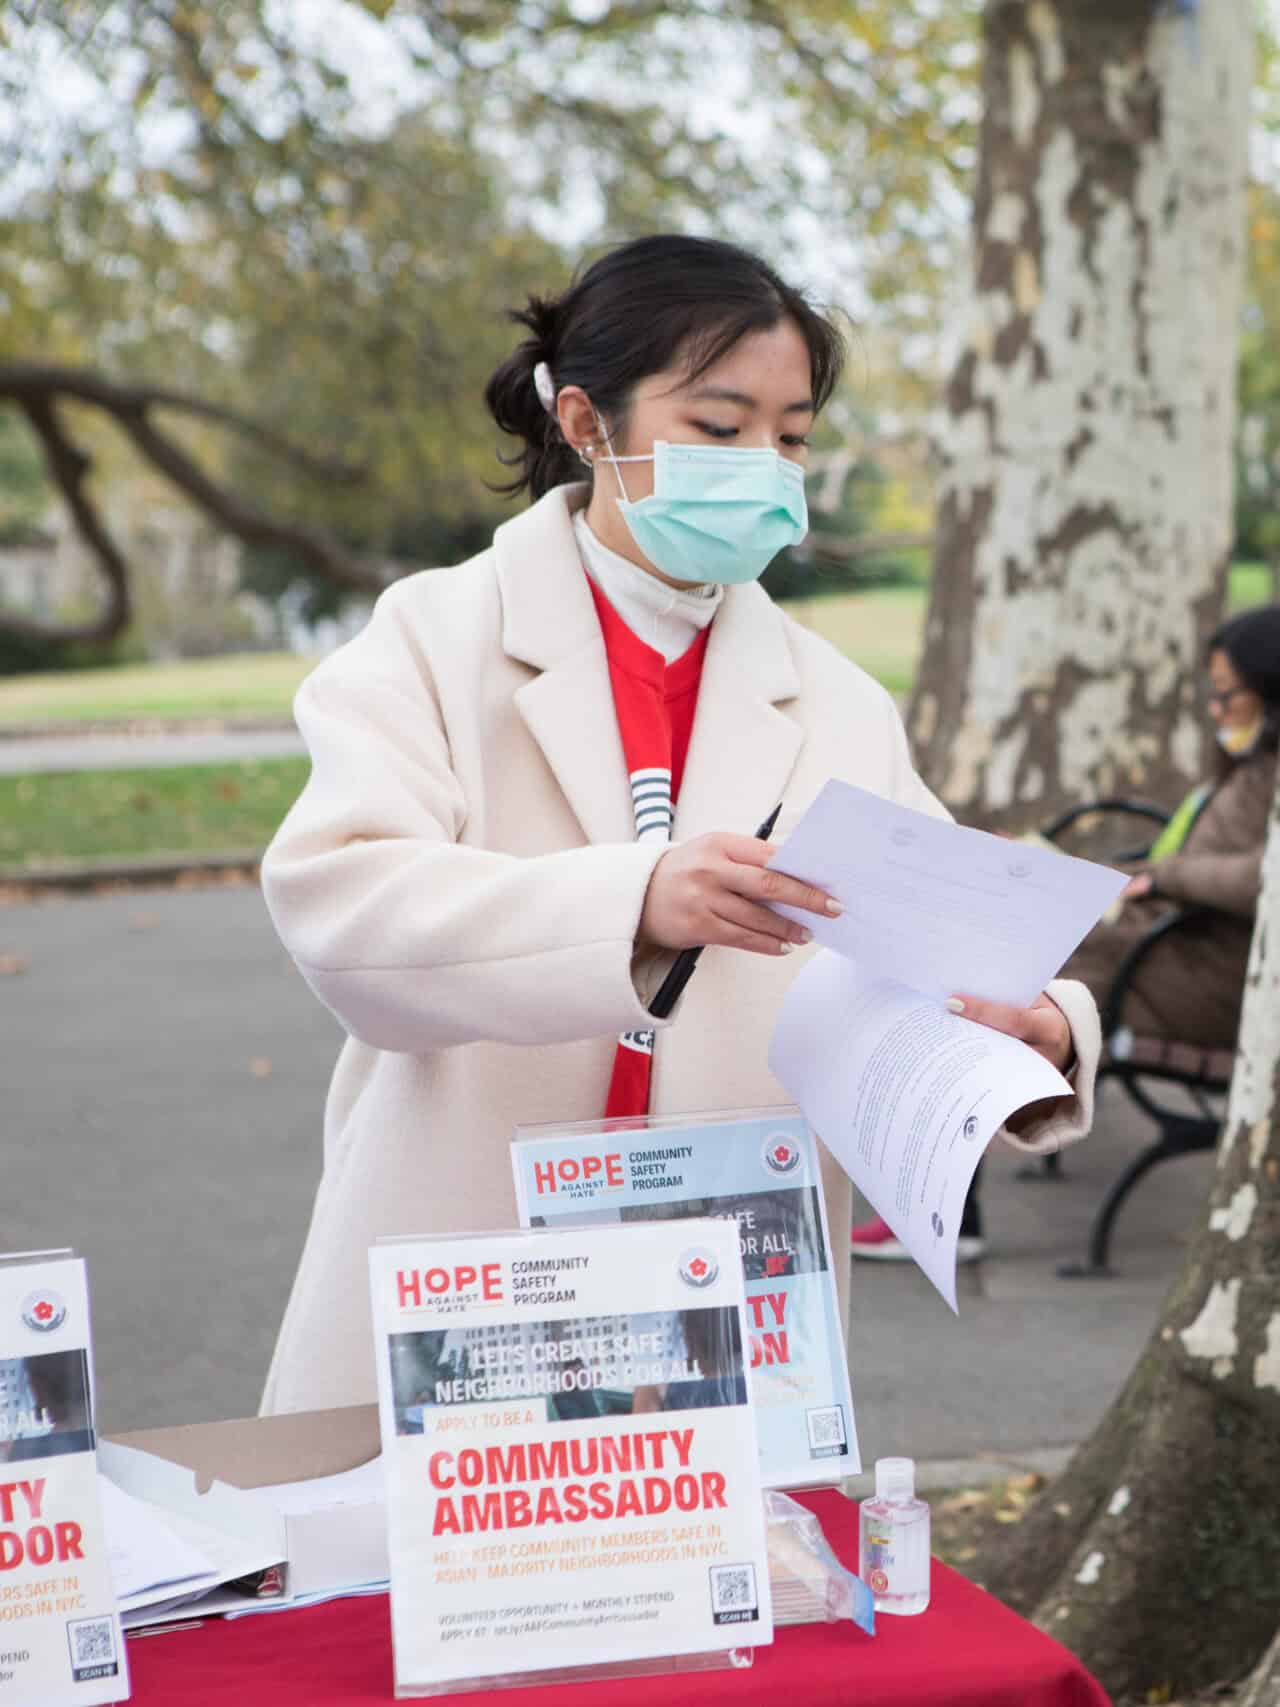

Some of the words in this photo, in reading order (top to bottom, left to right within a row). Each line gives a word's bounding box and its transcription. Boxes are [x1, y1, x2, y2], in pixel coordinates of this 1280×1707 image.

[629, 1146, 692, 1163] COMMUNITY
[534, 1154, 624, 1194] HOPE
[631, 1163, 666, 1177] SAFETY
[561, 1180, 604, 1192] AGAINST
[632, 1176, 683, 1191] PROGRAM
[570, 1191, 595, 1199] HATE
[762, 1233, 791, 1253] ALL
[512, 1257, 588, 1273] COMMUNITY
[396, 1263, 503, 1307] HOPE
[512, 1276, 556, 1289] SAFETY
[427, 1294, 479, 1305] AGAINST
[514, 1290, 576, 1305] PROGRAM
[531, 1337, 611, 1363] CREATE
[613, 1333, 663, 1359] SAFE
[435, 1366, 617, 1403] NEIGHBORHOODS
[669, 1358, 704, 1382] ALL
[480, 1411, 500, 1427] TO
[504, 1409, 521, 1425] BE
[525, 1408, 534, 1424] A
[428, 1429, 694, 1490] COMMUNITY
[432, 1471, 728, 1536] AMBASSADOR
[510, 1534, 596, 1558] COMMUNITY
[600, 1526, 668, 1547] MEMBERS
[672, 1525, 705, 1542] SAFE
[707, 1522, 721, 1537] IN
[487, 1559, 556, 1579] MAJORITY
[559, 1545, 678, 1572] NEIGHBORHOODS
[681, 1543, 697, 1559] IN
[699, 1540, 728, 1558] NYC
[63, 1576, 80, 1591] IN
[37, 1599, 53, 1616] IN
